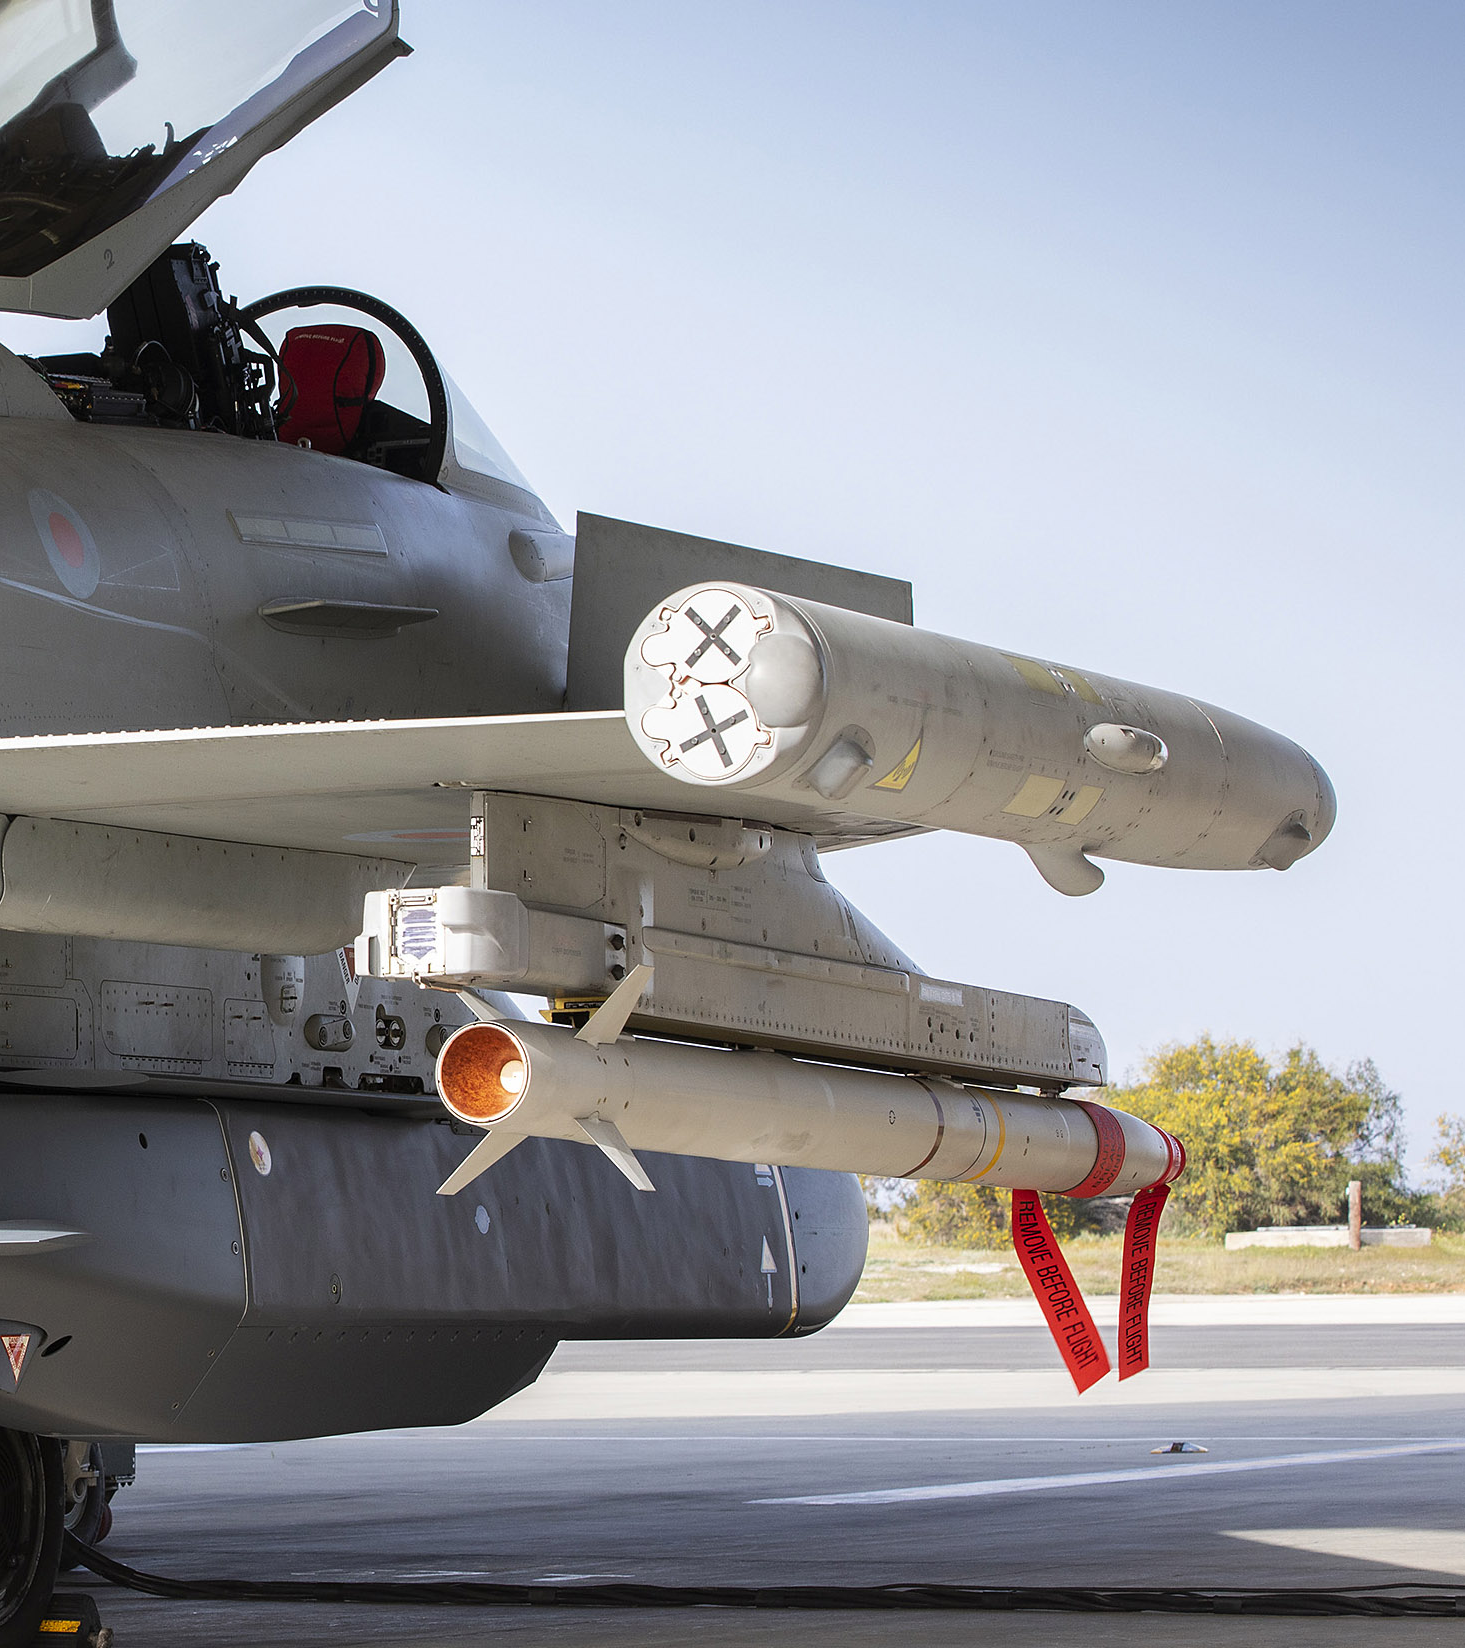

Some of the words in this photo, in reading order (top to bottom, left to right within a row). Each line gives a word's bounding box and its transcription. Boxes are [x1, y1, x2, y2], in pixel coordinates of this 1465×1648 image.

[1131, 1201, 1157, 1257] REMOVE
[1019, 1201, 1053, 1264] REMOVE
[1037, 1264, 1079, 1322] BEFORE
[1062, 1321, 1100, 1370] FLIGHT
[1125, 1257, 1149, 1314] BEFORE
[1125, 1313, 1143, 1366] FLIGHT
